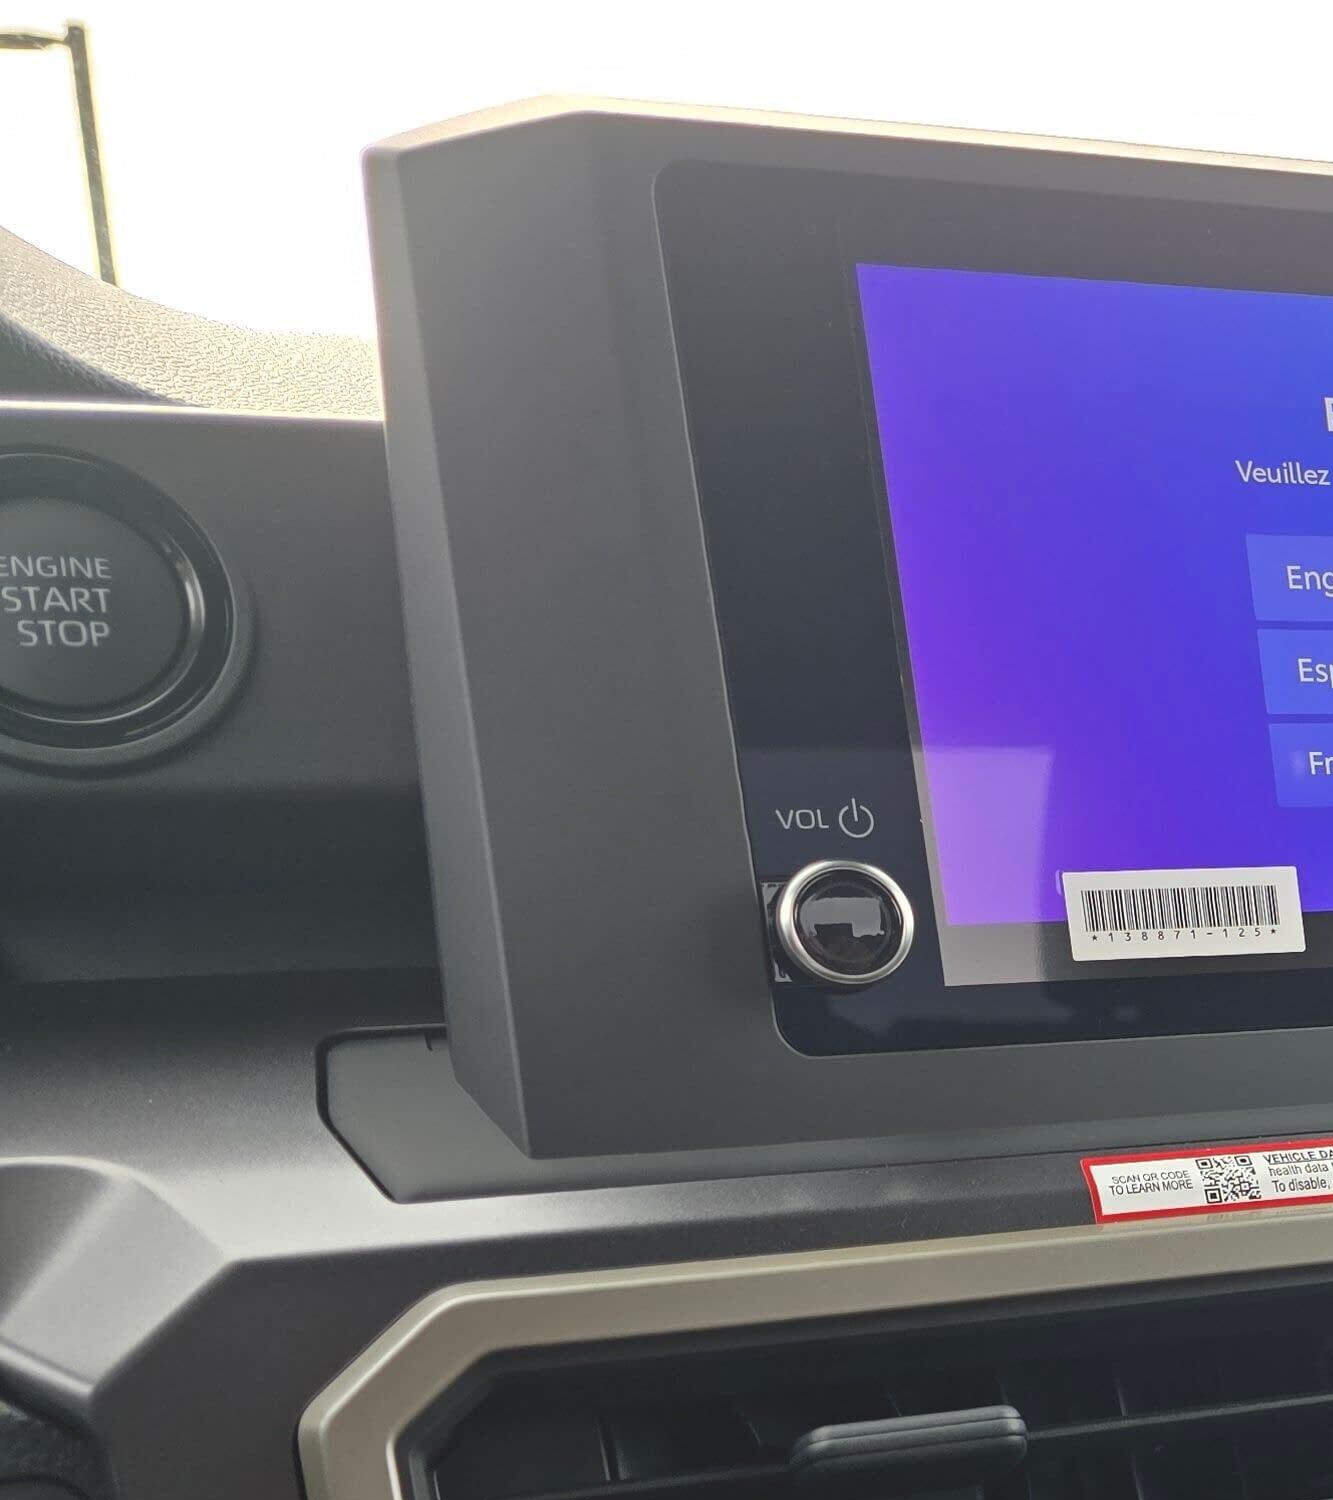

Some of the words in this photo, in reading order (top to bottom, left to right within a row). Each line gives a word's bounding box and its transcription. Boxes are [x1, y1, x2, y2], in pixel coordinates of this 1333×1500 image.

[1235, 460, 1330, 487] Veuillez
[0, 555, 111, 578] ENGINE
[1, 586, 111, 613] START
[17, 619, 109, 647] STOP
[775, 809, 828, 830] VOL
[1263, 1150, 1315, 1164] VEHICLE
[1111, 1174, 1140, 1184] SCAN
[1160, 1169, 1190, 1180] CODE
[1268, 1163, 1302, 1176] health
[1305, 1161, 1328, 1173] data
[1109, 1185, 1123, 1196] TO
[1125, 1182, 1160, 1194] LEARN
[1162, 1179, 1193, 1191] MORE
[1272, 1179, 1285, 1192] To
[1288, 1175, 1330, 1193] disable,
